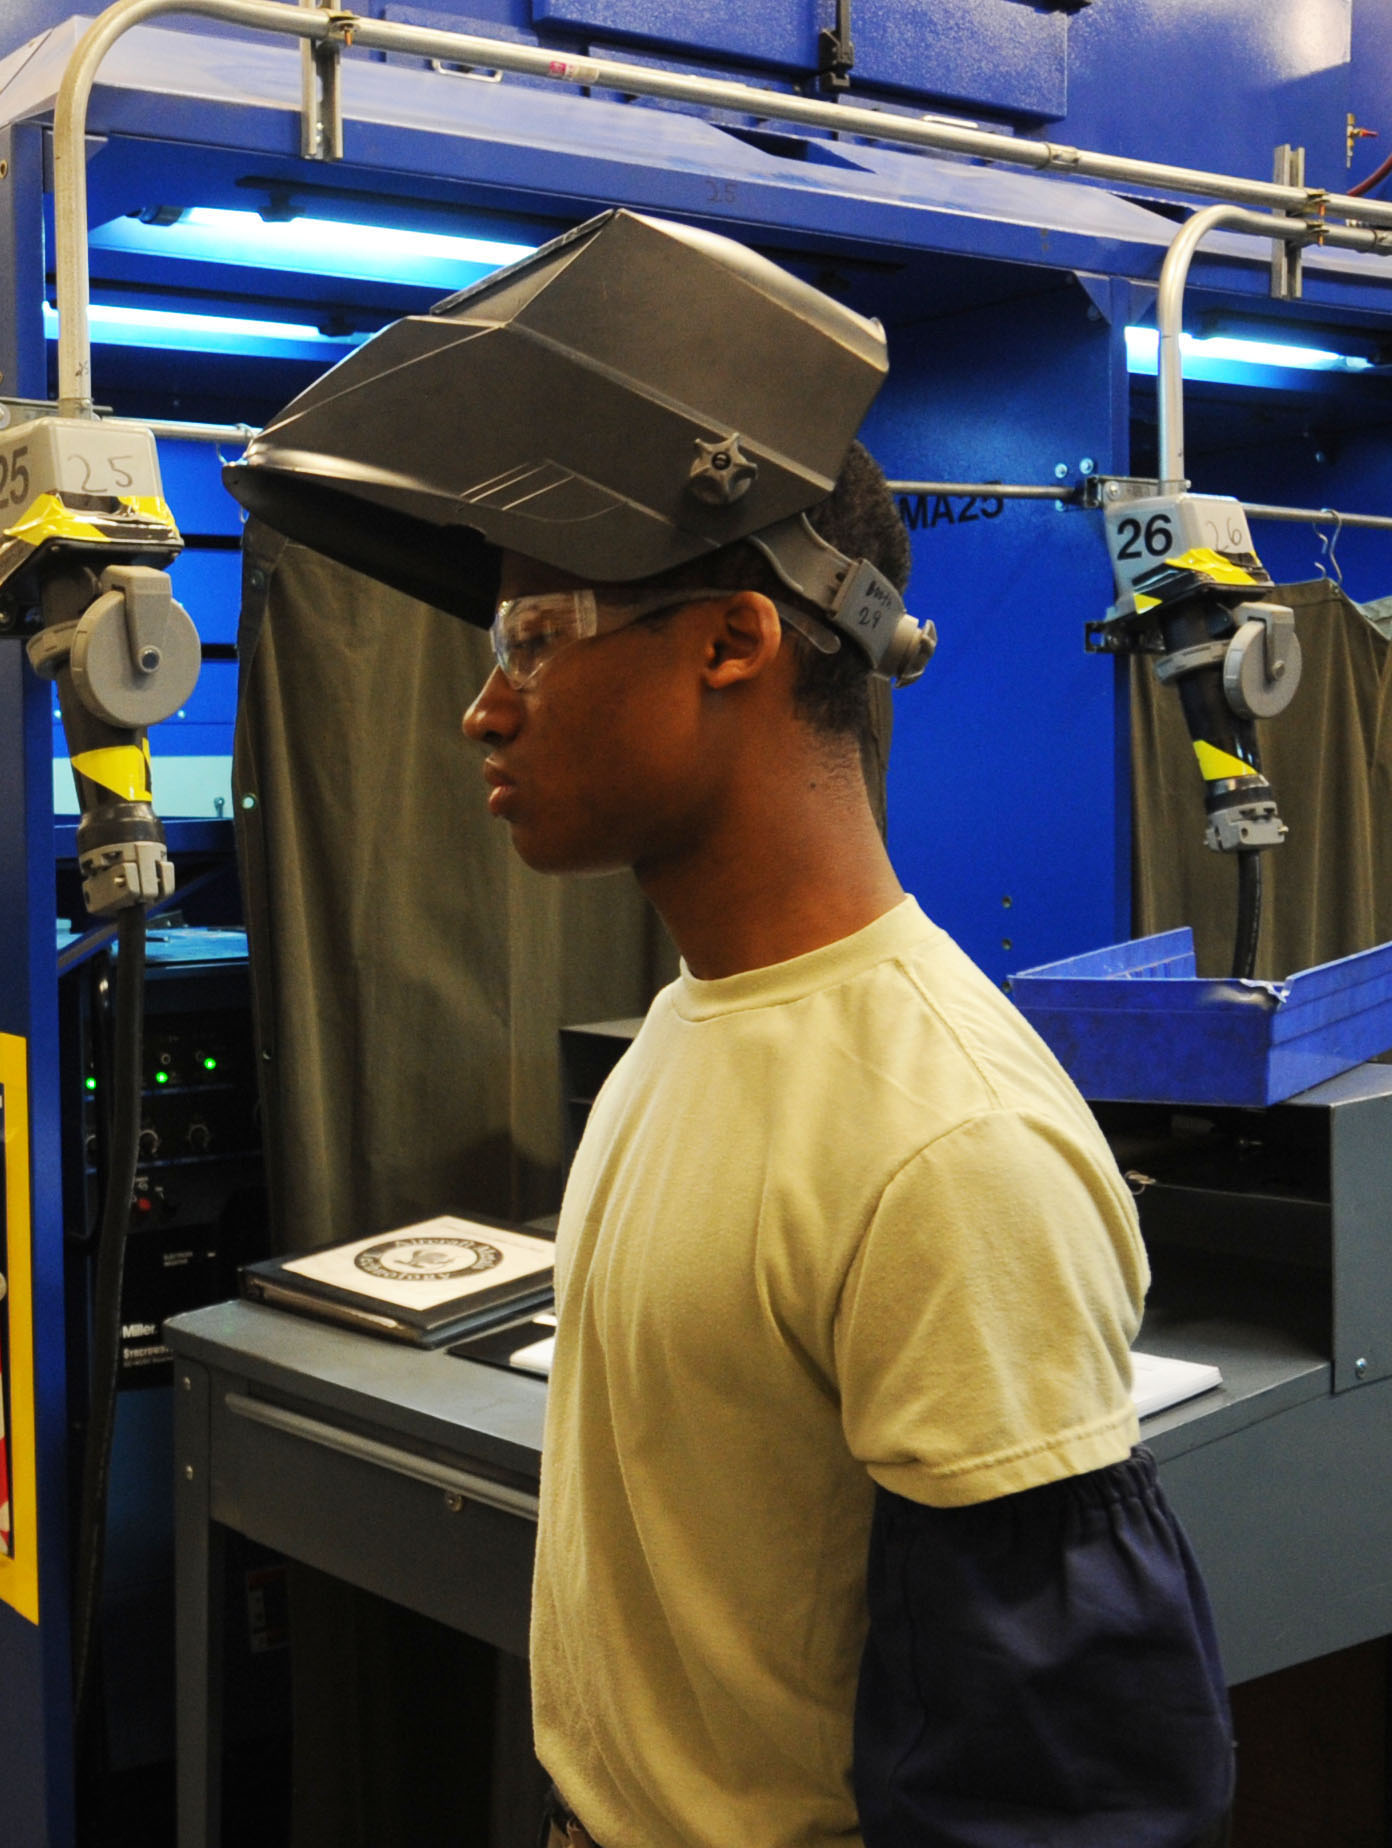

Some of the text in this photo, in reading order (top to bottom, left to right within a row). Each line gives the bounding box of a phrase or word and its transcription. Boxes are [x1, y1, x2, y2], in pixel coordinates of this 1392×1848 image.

[67, 453, 134, 494] 25
[1116, 513, 1173, 561] 26
[1206, 515, 1243, 552] 26
